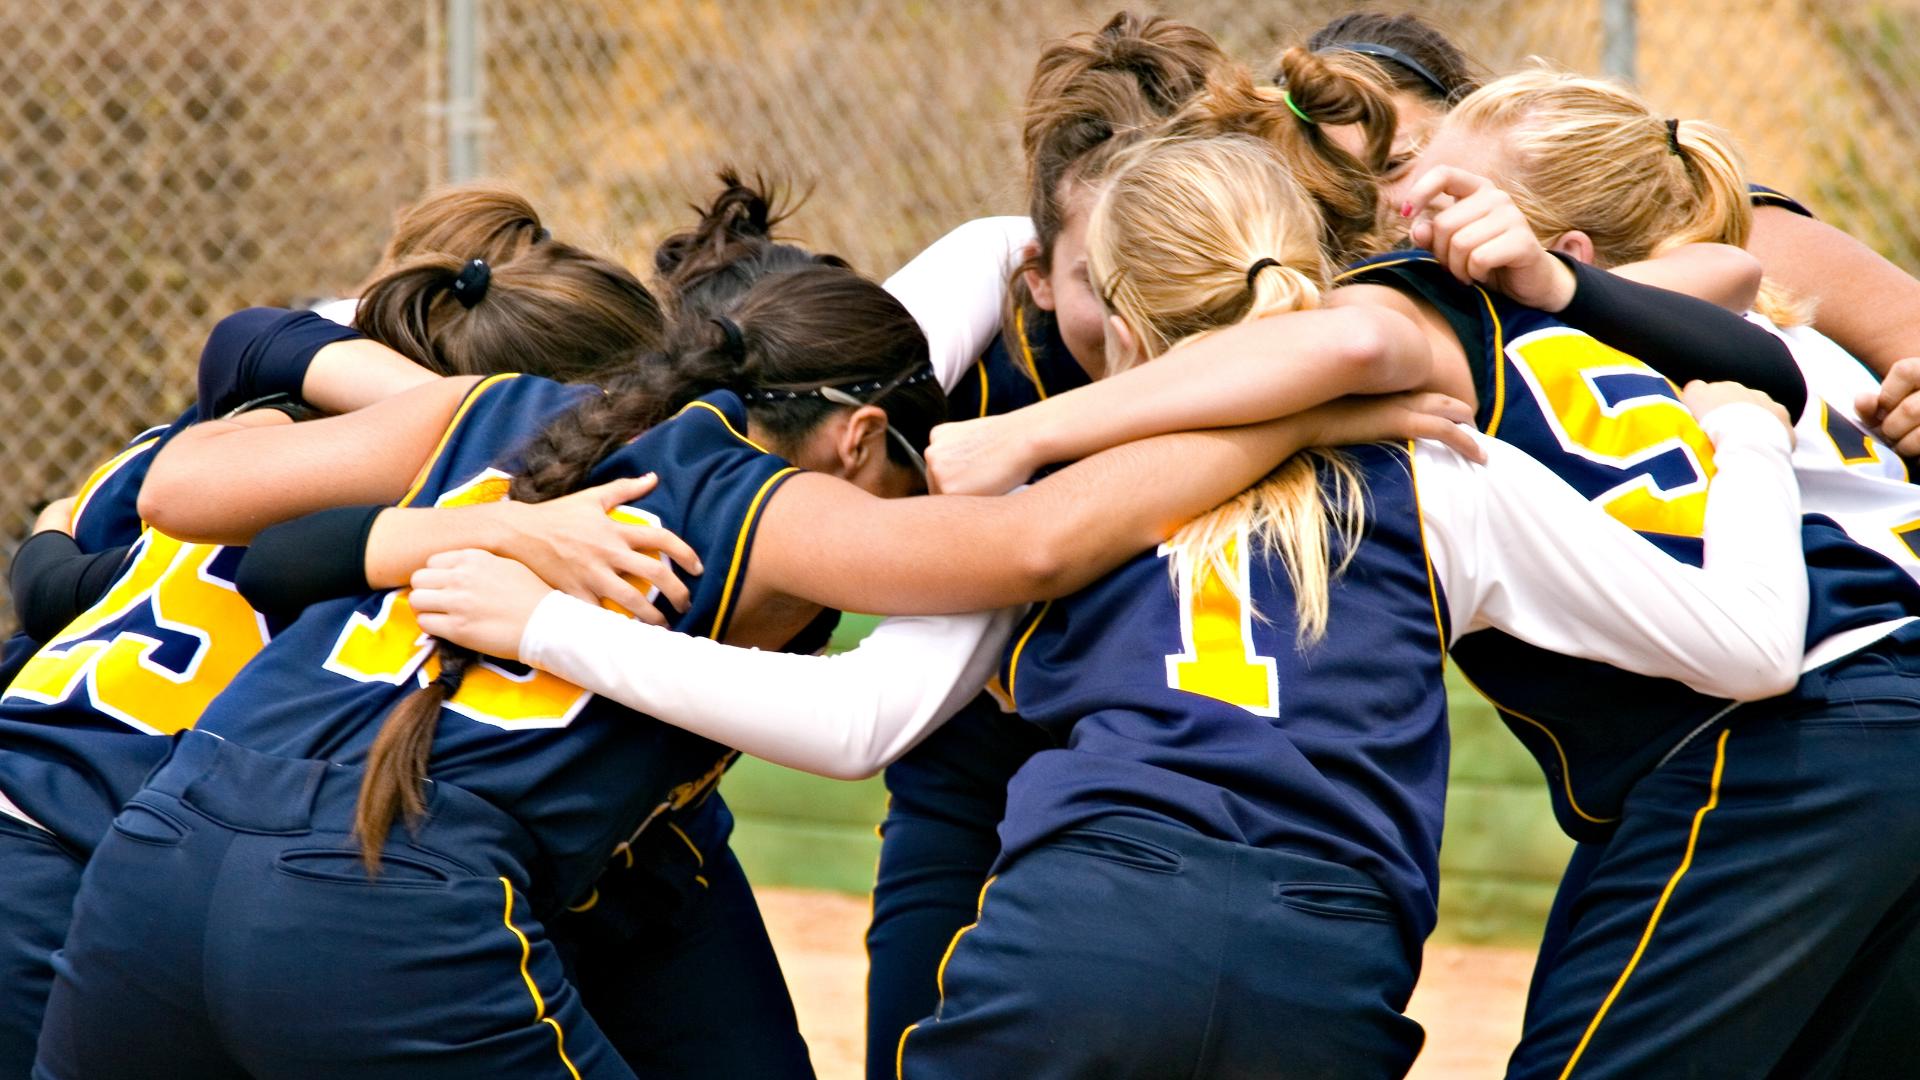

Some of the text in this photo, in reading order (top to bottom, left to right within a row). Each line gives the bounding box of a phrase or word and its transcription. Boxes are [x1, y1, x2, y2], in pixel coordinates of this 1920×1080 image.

[1503, 326, 1718, 539] 5
[1, 527, 271, 735] 25
[1157, 522, 1280, 718] 1
